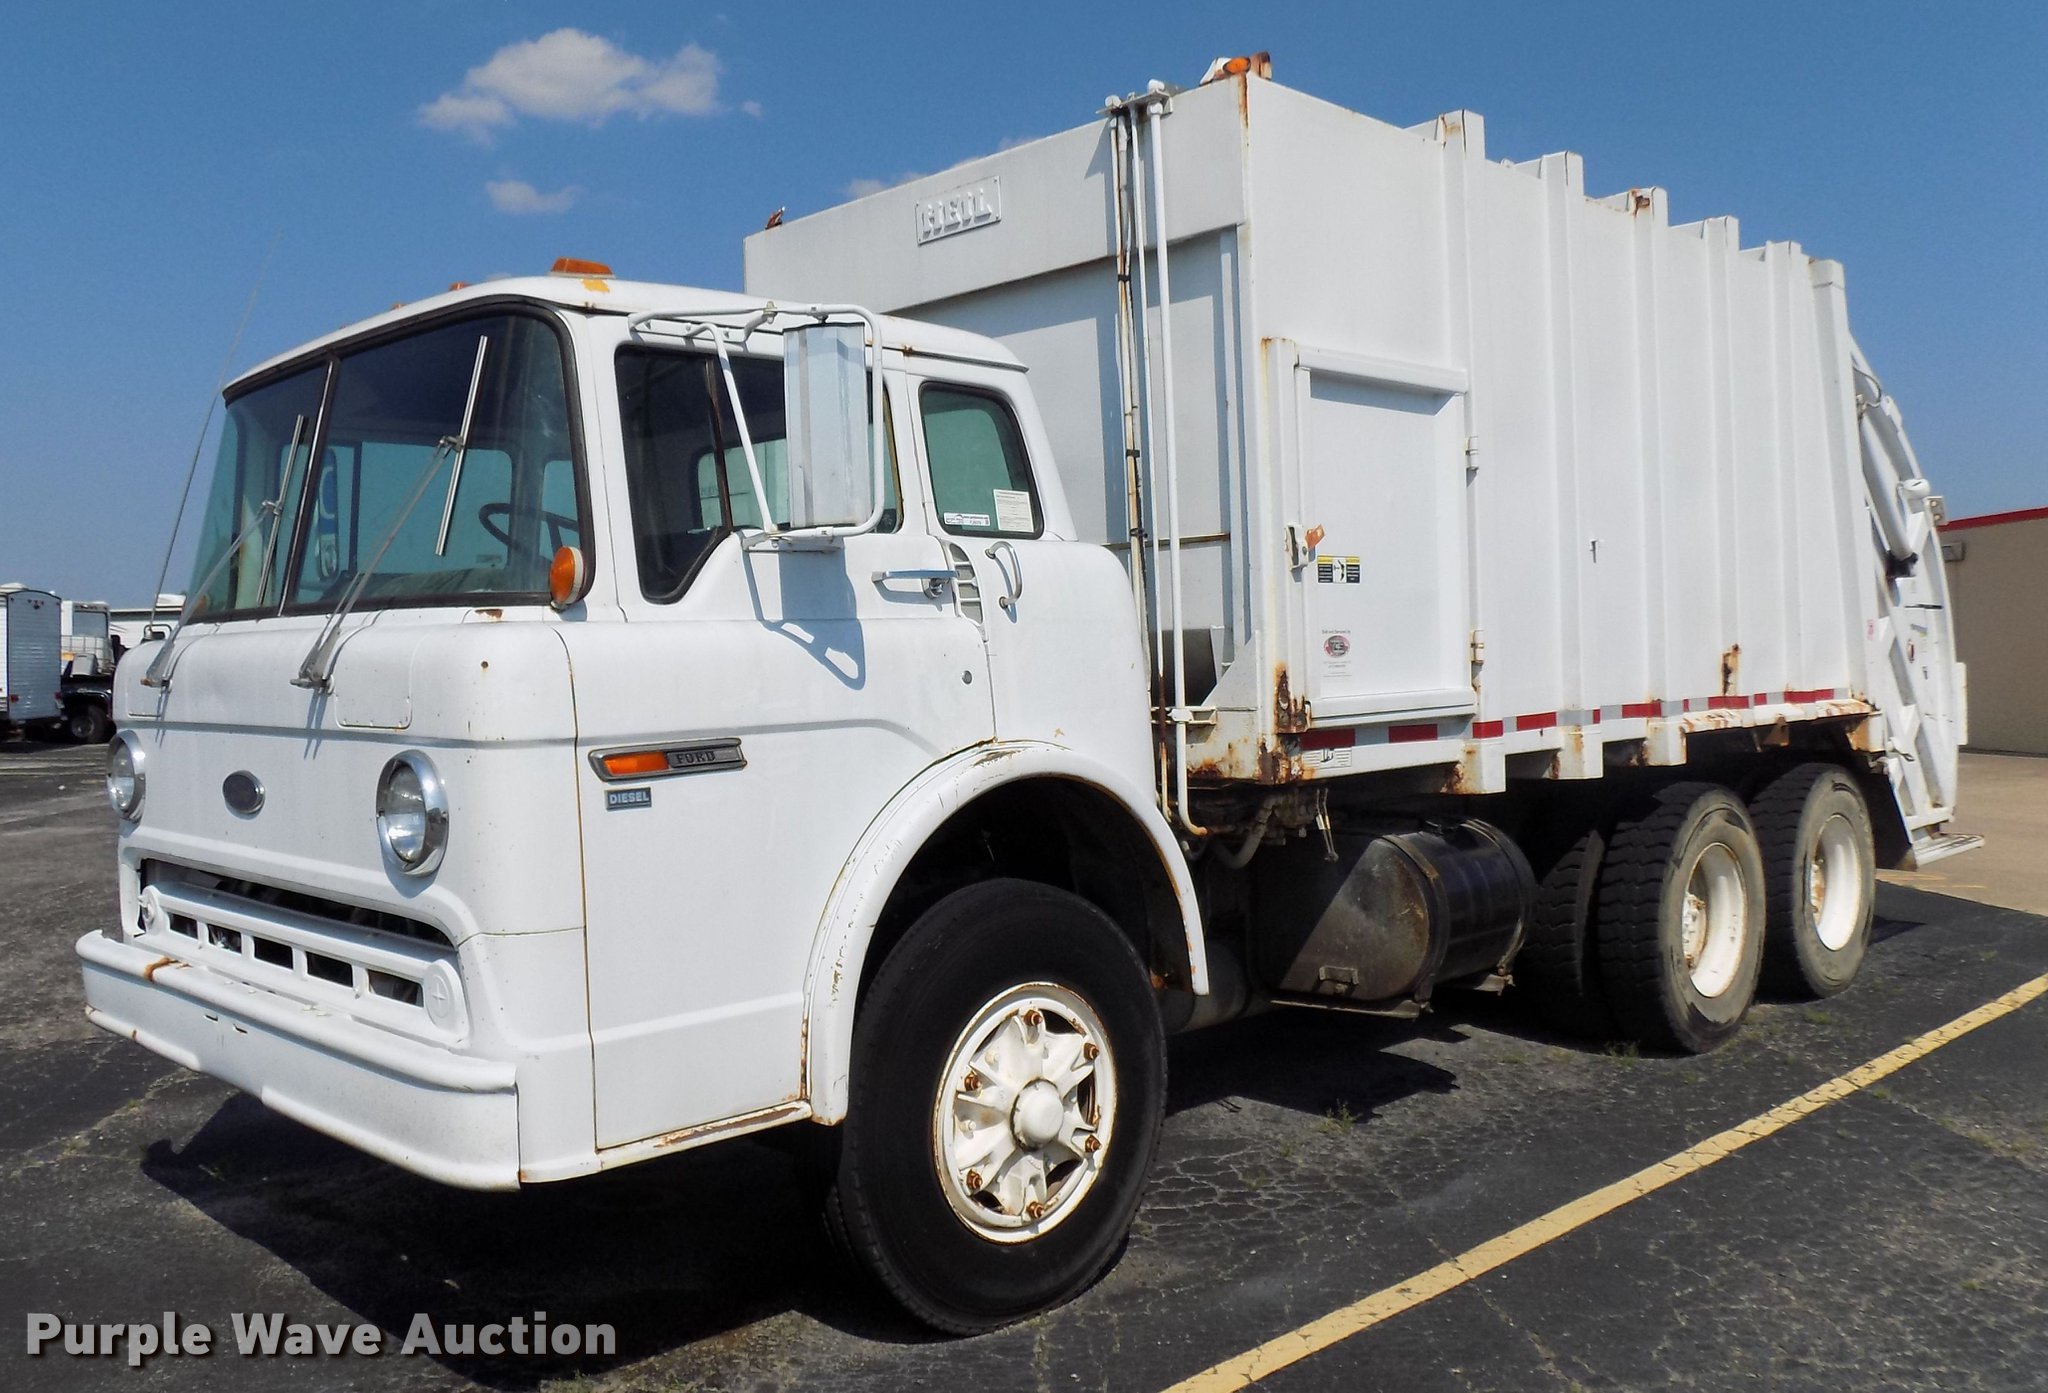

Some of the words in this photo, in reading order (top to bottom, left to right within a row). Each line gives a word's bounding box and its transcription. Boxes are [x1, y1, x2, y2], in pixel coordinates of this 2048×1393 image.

[921, 188, 993, 237] HEIL
[676, 750, 716, 765] FORD
[609, 791, 650, 805] DIESEL
